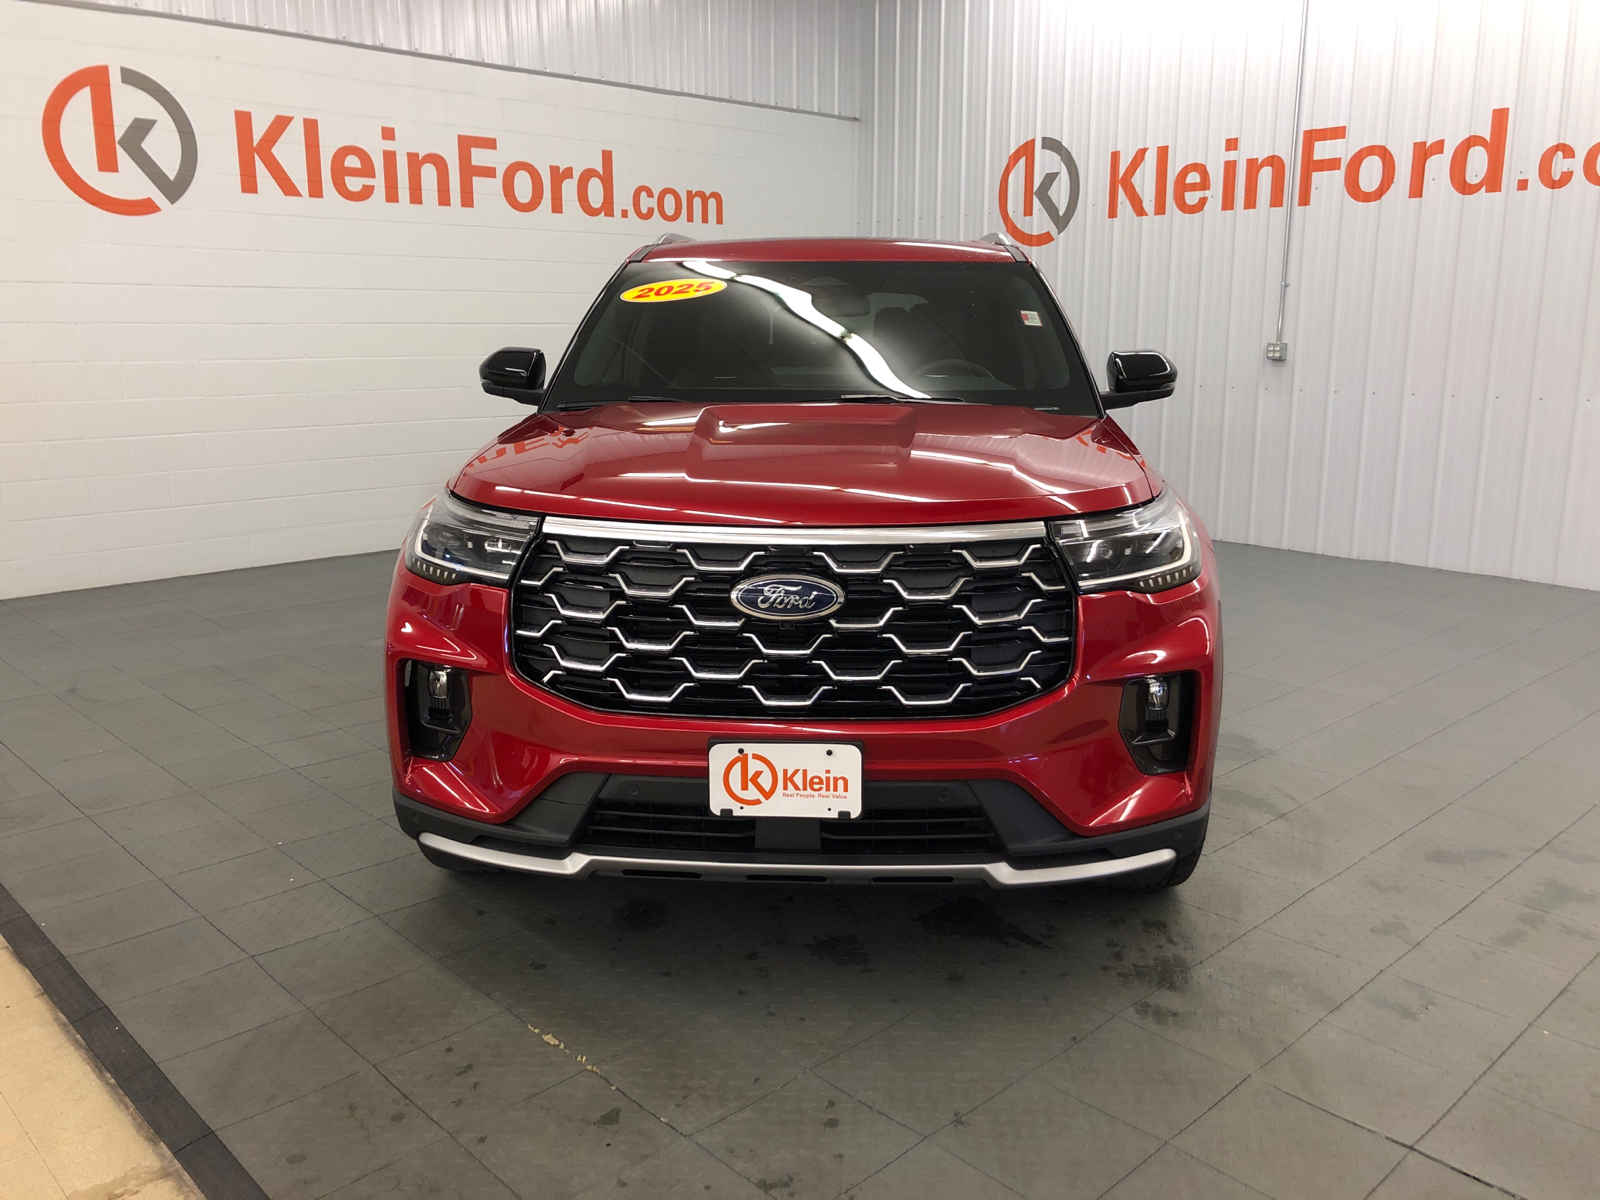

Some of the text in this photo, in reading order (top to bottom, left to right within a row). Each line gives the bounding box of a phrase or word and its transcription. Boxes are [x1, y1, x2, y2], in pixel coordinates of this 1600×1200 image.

[234, 109, 725, 226] KleinFord.com
[632, 281, 715, 300] 2025
[757, 584, 816, 609] Ford
[782, 768, 849, 793] Klein
